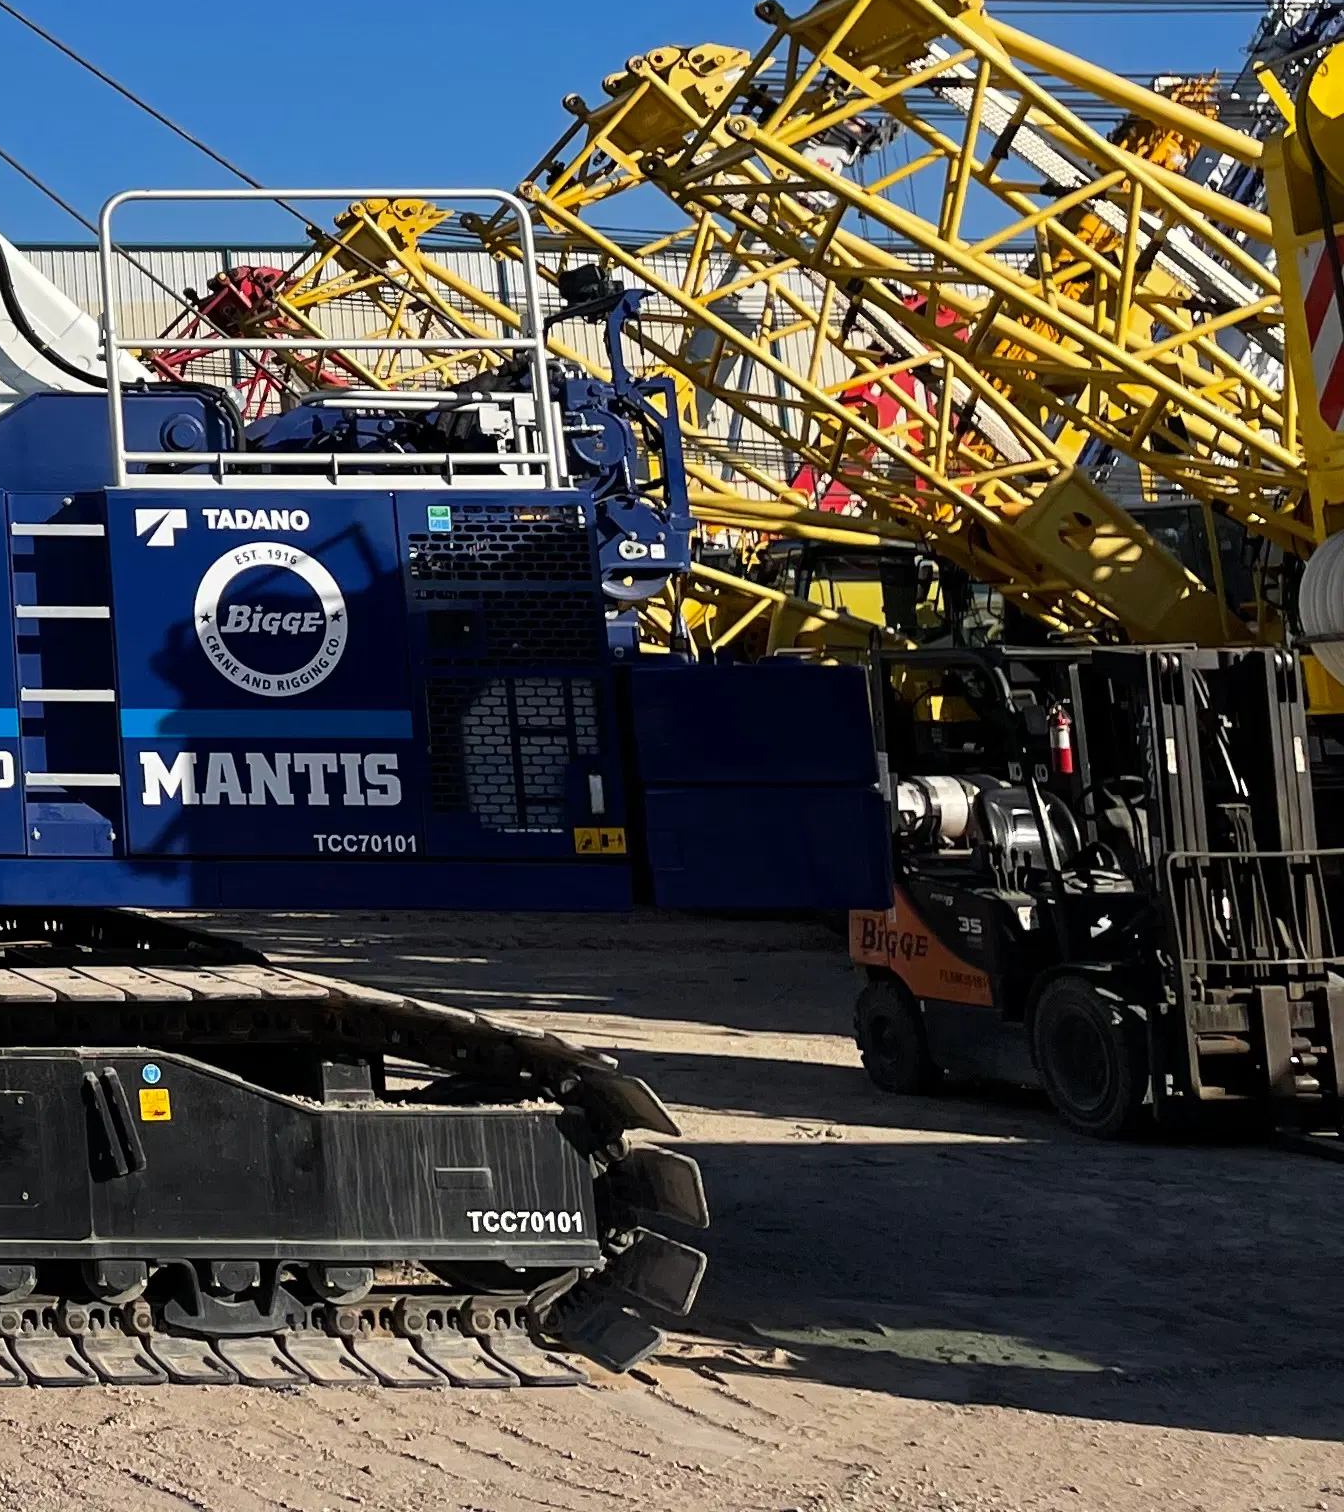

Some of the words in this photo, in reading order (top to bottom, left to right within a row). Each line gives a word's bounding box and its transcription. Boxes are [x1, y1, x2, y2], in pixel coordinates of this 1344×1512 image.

[202, 508, 310, 532] TADANO
[234, 549, 262, 565] EST.
[268, 548, 298, 565] 1916
[205, 635, 240, 677] CRANE
[241, 673, 272, 690] AND
[277, 657, 330, 691] RIGGING
[139, 751, 402, 806] MANTIS
[313, 834, 417, 853] TCC70101
[958, 916, 983, 934] 35
[466, 1210, 583, 1233] TCC70101
